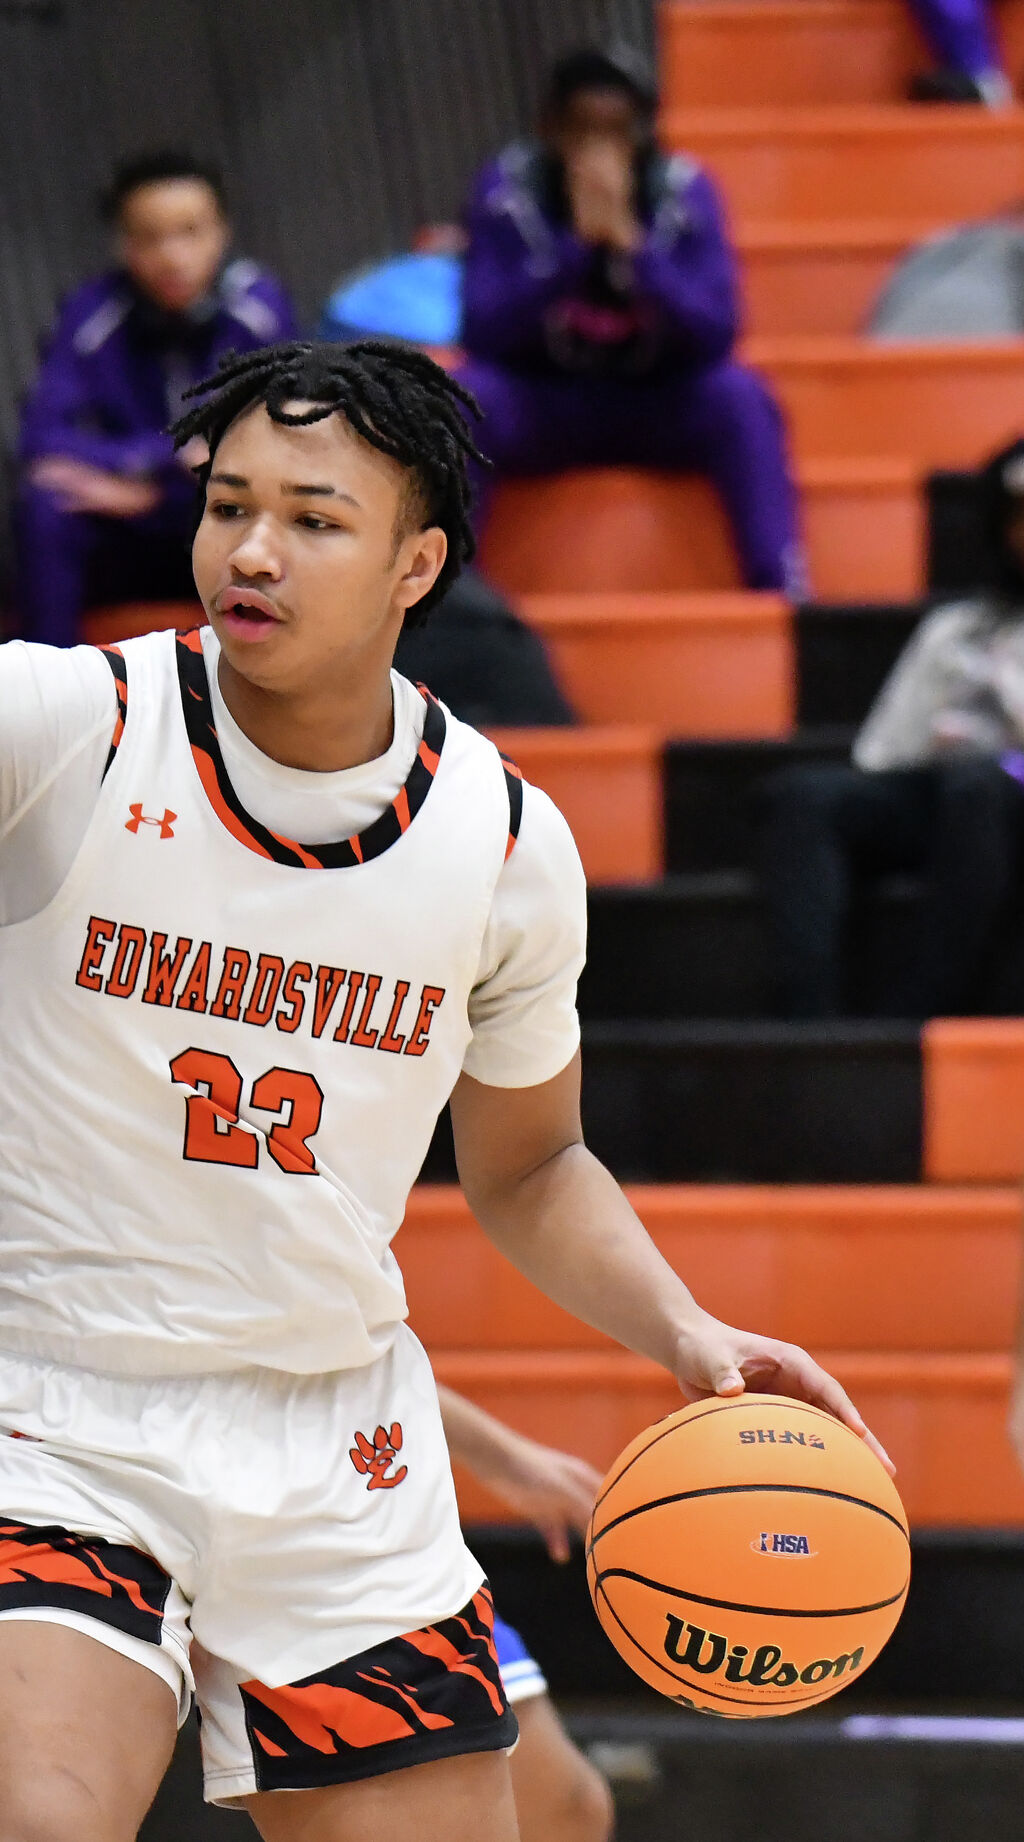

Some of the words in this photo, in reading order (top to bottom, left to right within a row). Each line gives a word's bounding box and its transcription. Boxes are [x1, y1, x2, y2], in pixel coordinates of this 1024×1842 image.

[75, 915, 445, 1056] EDWARDSVILLE
[169, 1046, 325, 1176] 23
[759, 1532, 810, 1555] IHSA
[664, 1611, 865, 1687] Wilson
